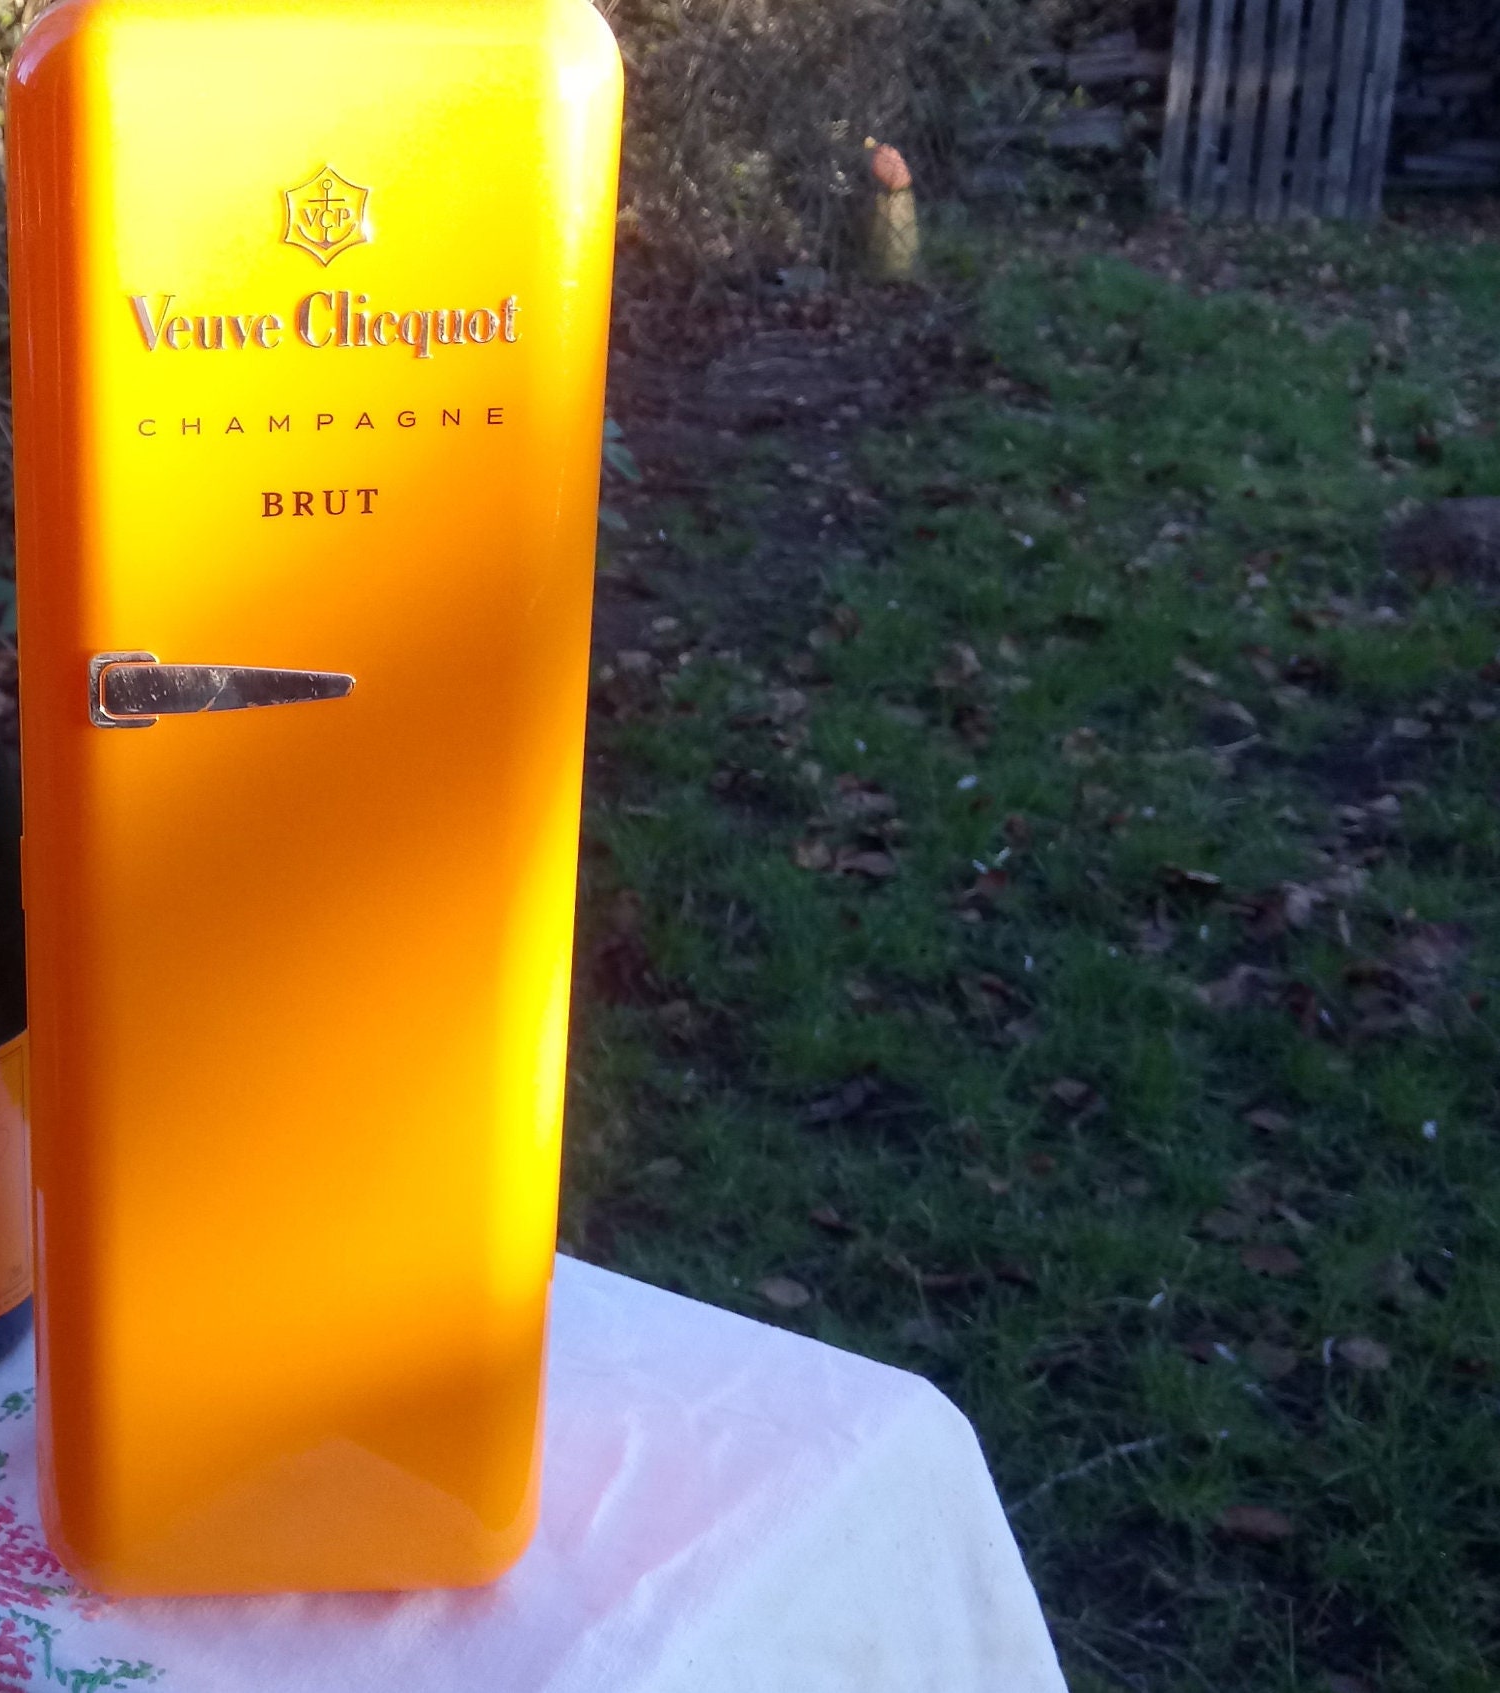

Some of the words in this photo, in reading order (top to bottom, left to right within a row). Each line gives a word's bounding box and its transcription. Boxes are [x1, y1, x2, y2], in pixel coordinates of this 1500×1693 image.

[302, 207, 351, 229] VCP
[126, 293, 282, 352] Veuve
[297, 290, 522, 359] Clicquot
[137, 407, 505, 438] CHAMPAGNE
[261, 488, 379, 518] BRUT
